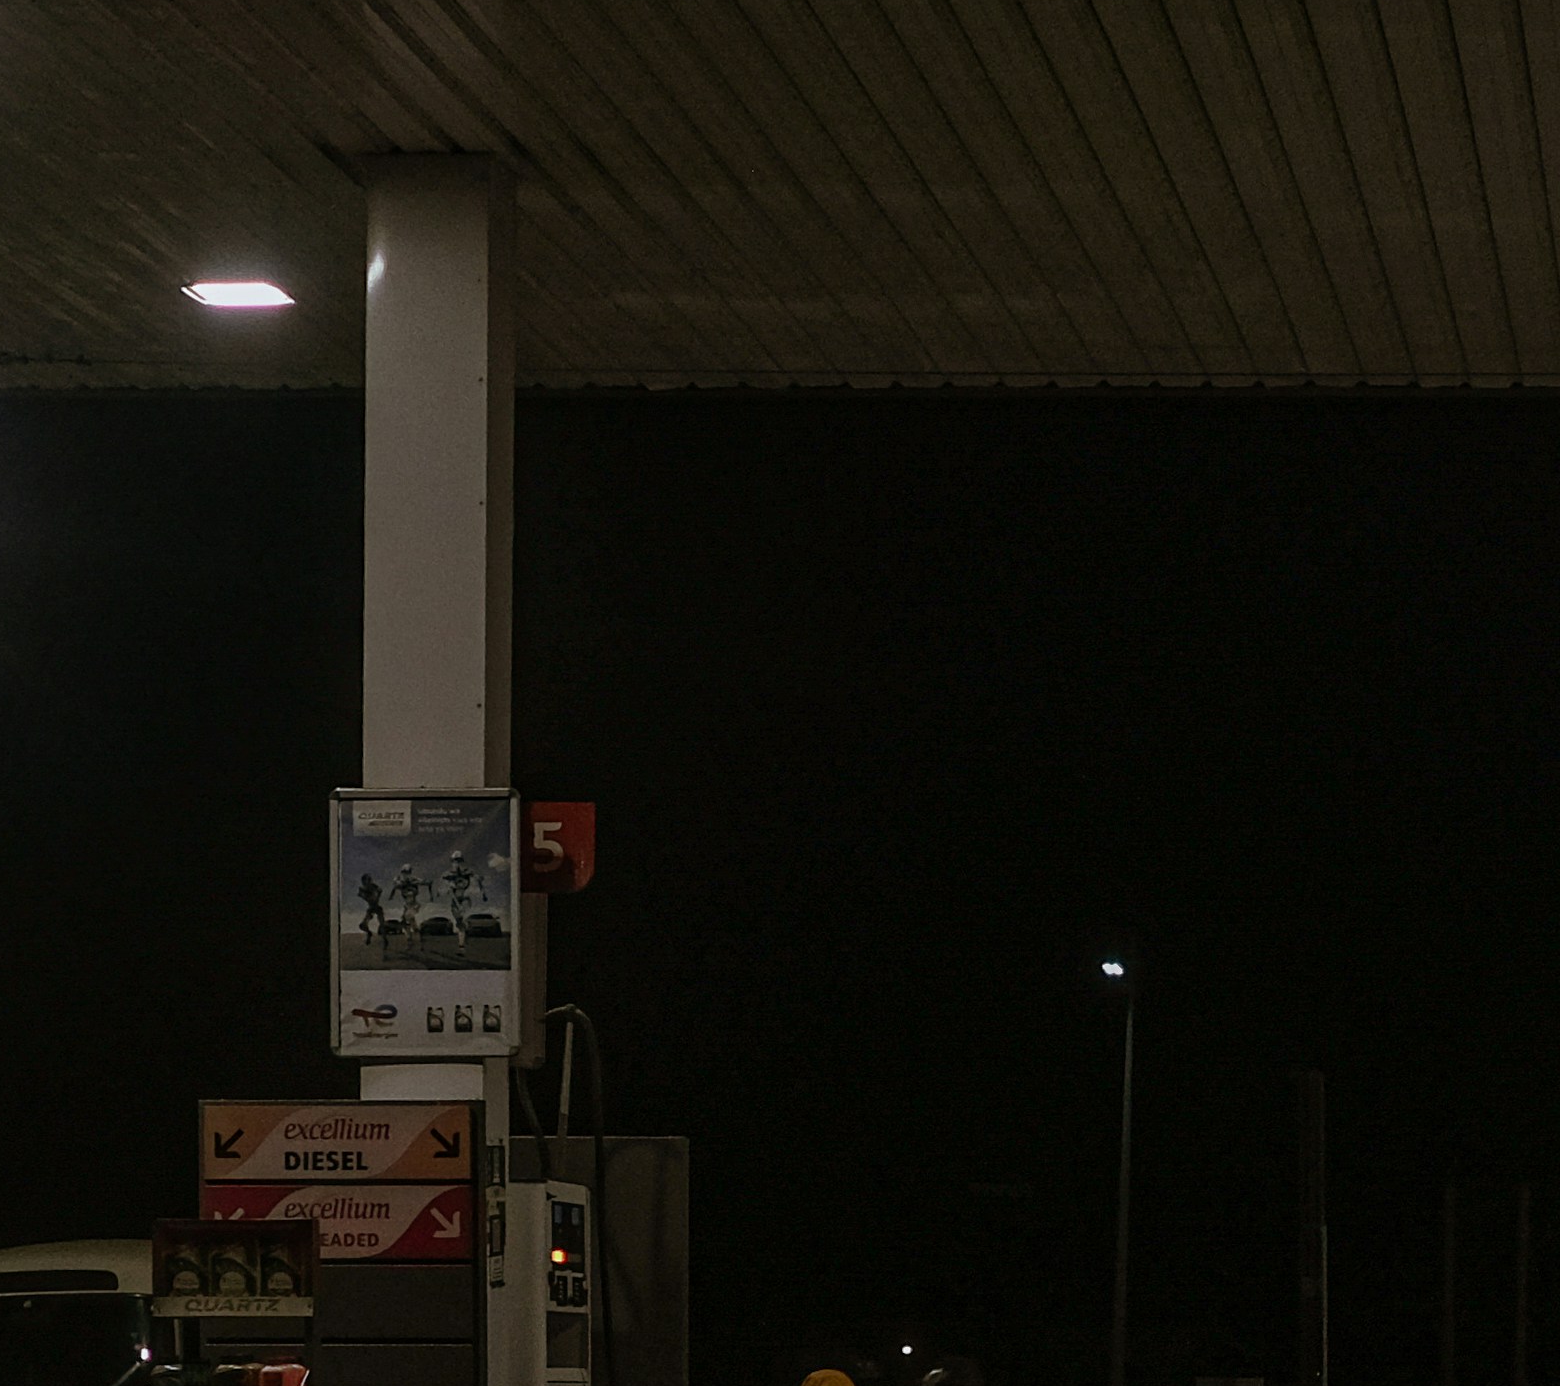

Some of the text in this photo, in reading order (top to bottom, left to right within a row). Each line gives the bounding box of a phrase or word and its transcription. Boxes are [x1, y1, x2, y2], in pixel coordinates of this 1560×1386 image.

[532, 821, 565, 873] 5
[283, 1118, 391, 1141] excellium
[283, 1151, 369, 1171] DIESEL
[283, 1197, 391, 1220] excellium
[320, 1232, 380, 1248] EADED
[184, 1298, 281, 1312] QUARTZ
